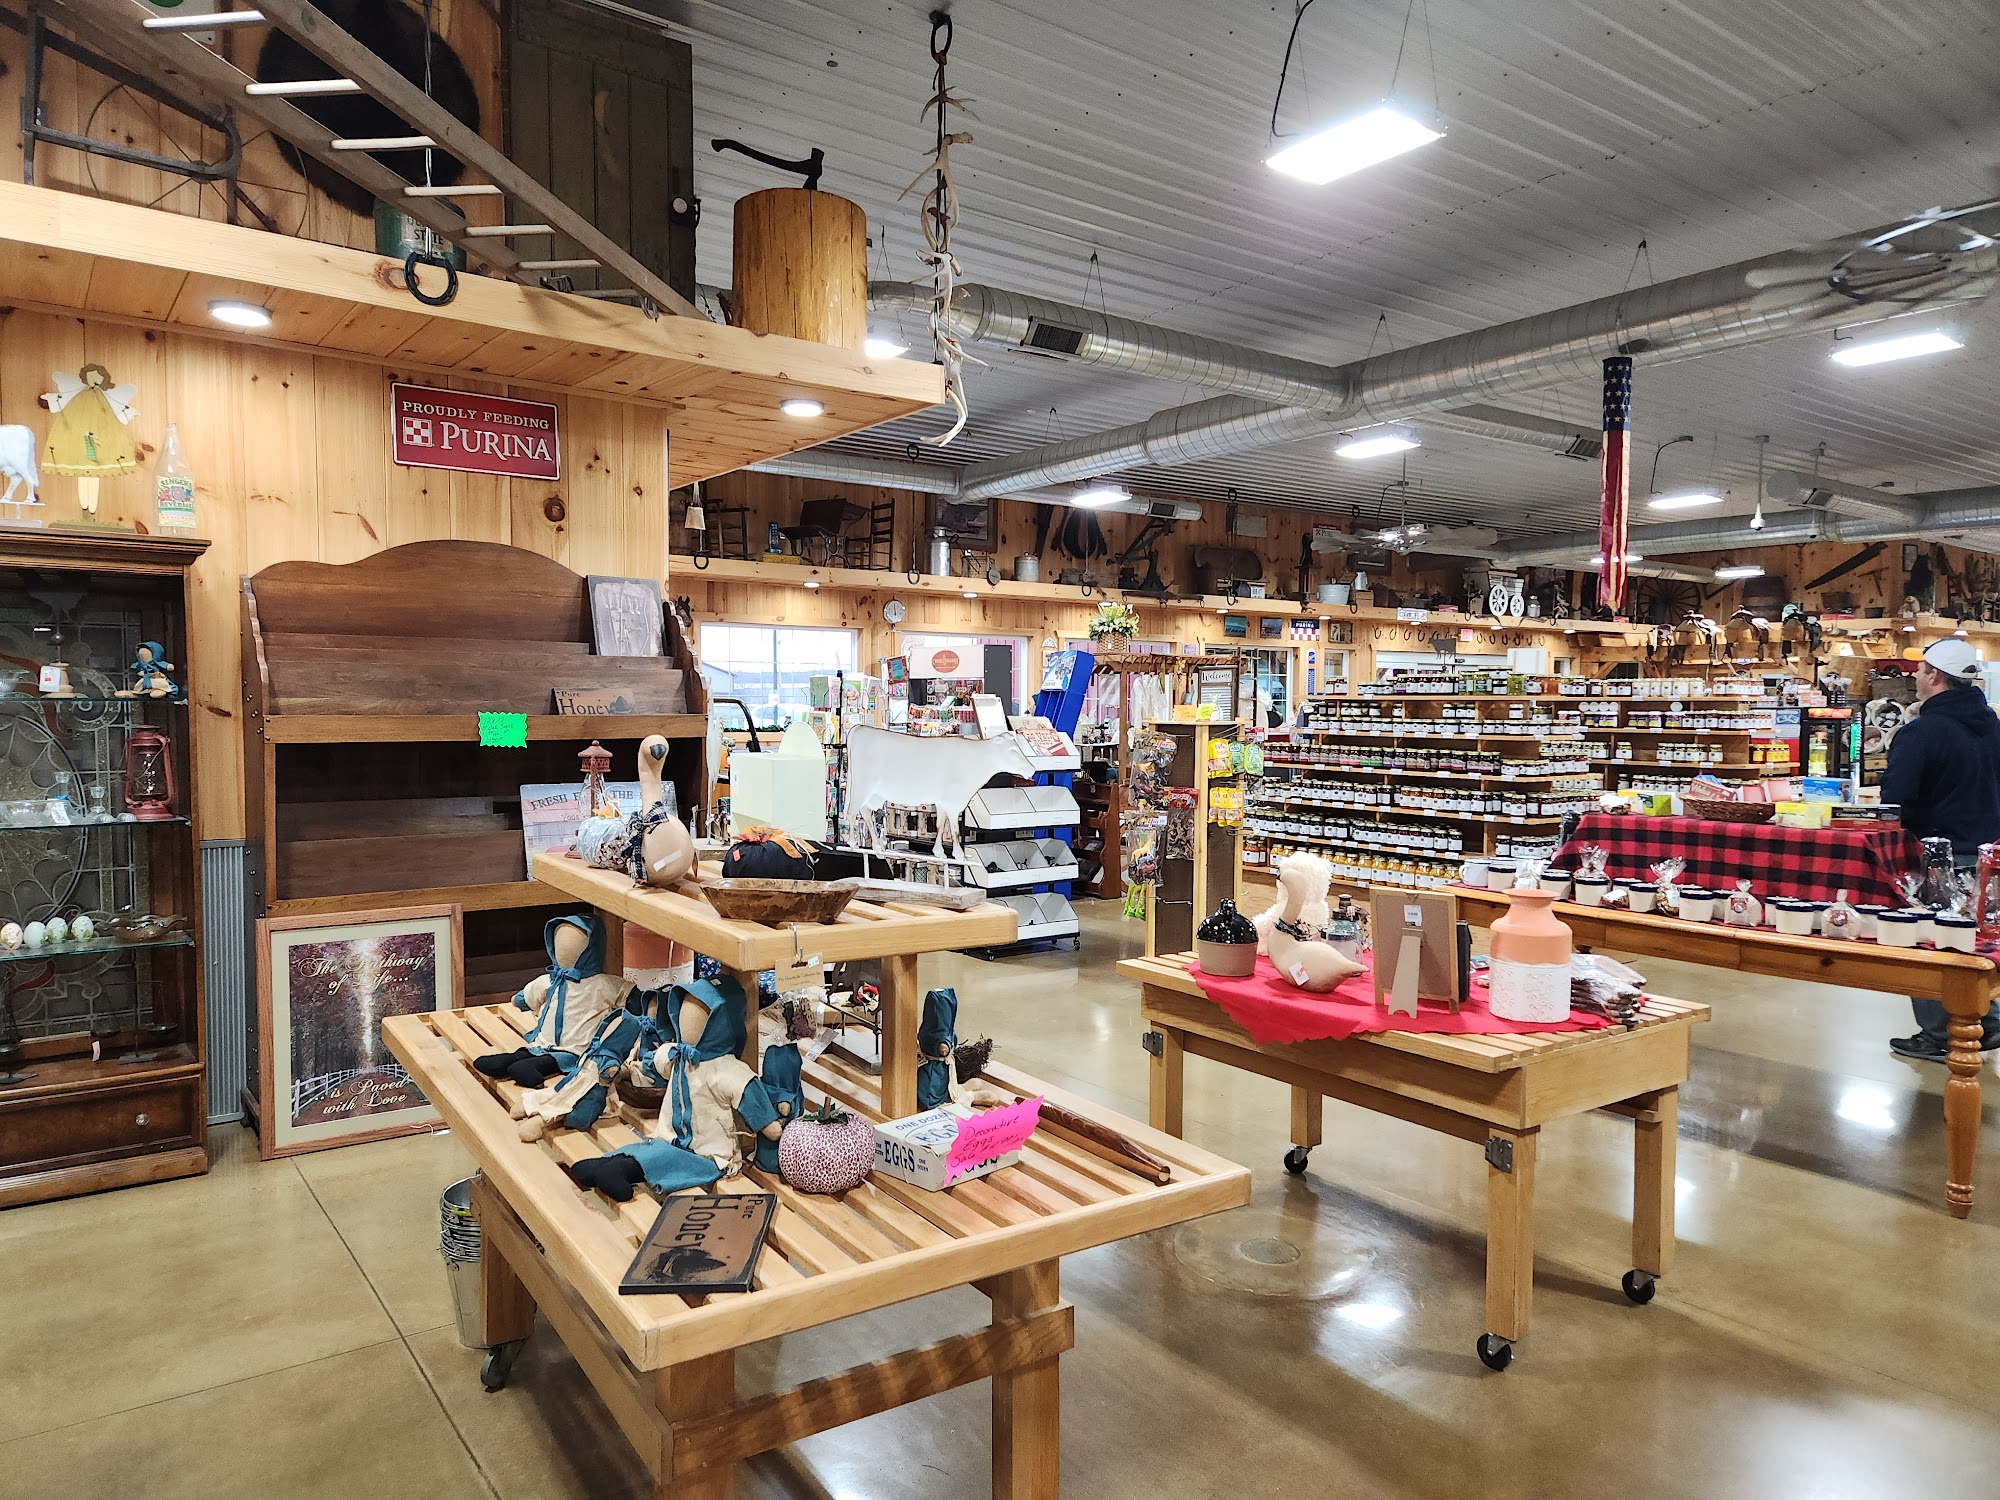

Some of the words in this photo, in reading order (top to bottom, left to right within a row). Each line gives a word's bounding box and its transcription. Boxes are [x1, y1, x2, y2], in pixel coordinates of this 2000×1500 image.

[414, 228, 444, 246] STTE
[401, 400, 478, 421] PROUDLY
[482, 410, 550, 430] FEEDING
[439, 420, 554, 462] PURINA
[1202, 671, 1231, 682] Welcome
[560, 690, 581, 698] Pure
[530, 793, 569, 811] FRESH
[610, 789, 634, 800] THE
[299, 956, 338, 978] The
[344, 952, 426, 972] Pathway
[327, 974, 349, 996] of
[349, 1074, 410, 1095] Paved
[322, 1096, 359, 1115] with
[361, 1090, 408, 1107] Love
[895, 1120, 919, 1131] ONE
[884, 1139, 915, 1173] EGGS
[741, 1194, 764, 1220] Pure
[651, 1196, 743, 1249] Honey
